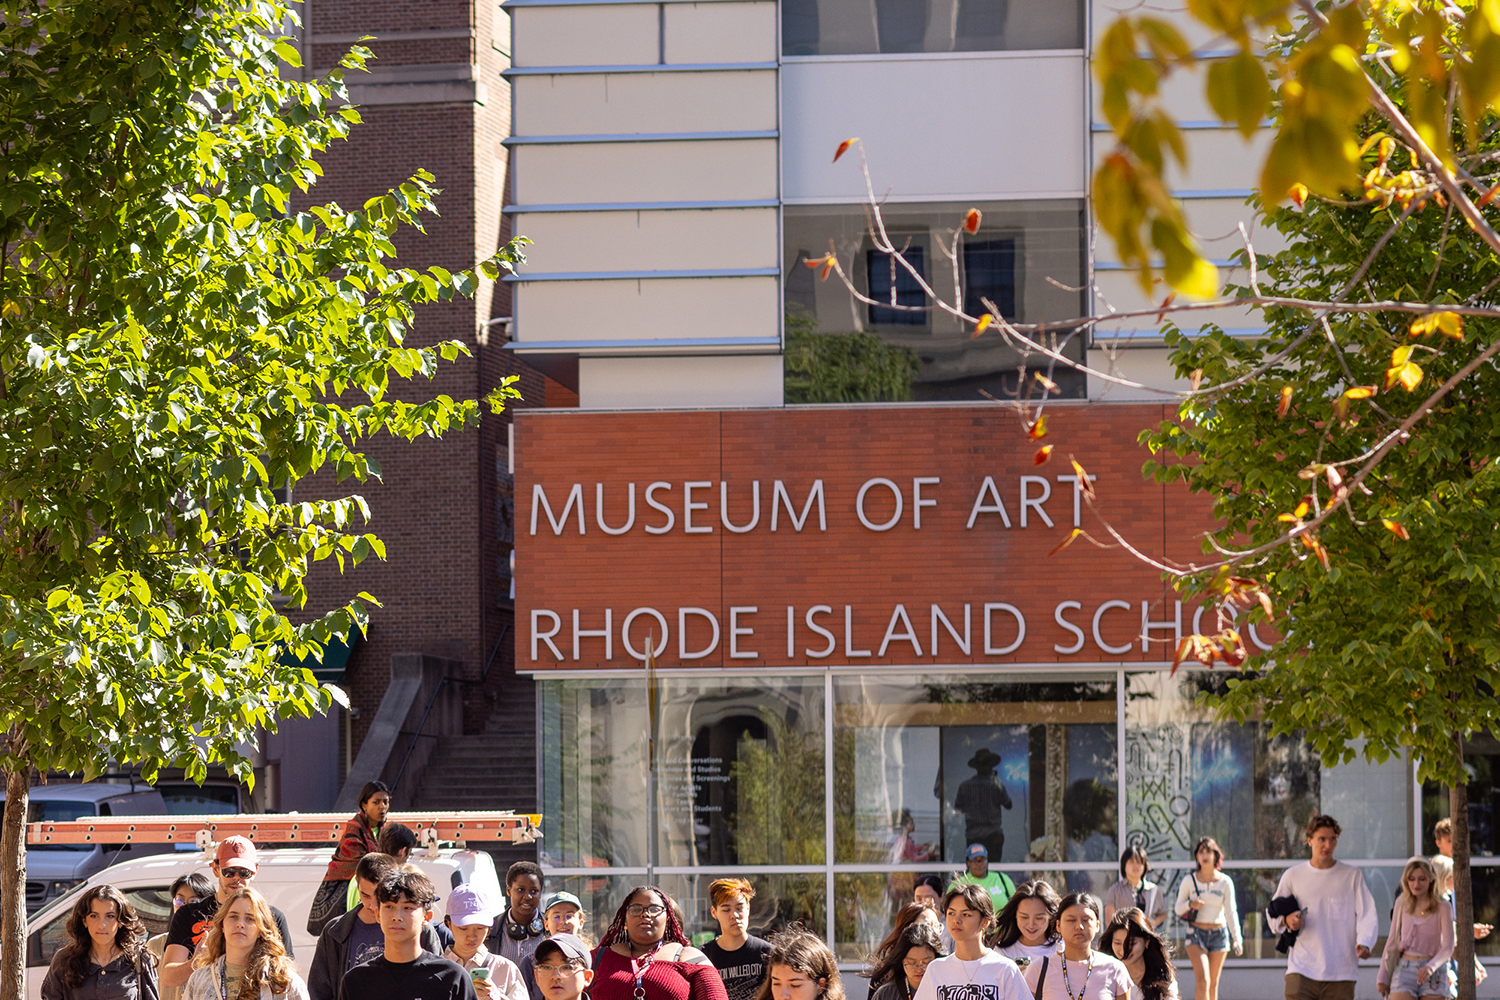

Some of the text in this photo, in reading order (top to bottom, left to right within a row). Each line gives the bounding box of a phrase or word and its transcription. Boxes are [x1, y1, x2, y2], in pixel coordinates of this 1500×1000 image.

[529, 475, 1097, 536] MUSEUM OF ART
[530, 606, 759, 661] RHODE
[787, 601, 1026, 658] ISLAND
[750, 962, 763, 976] CITY
